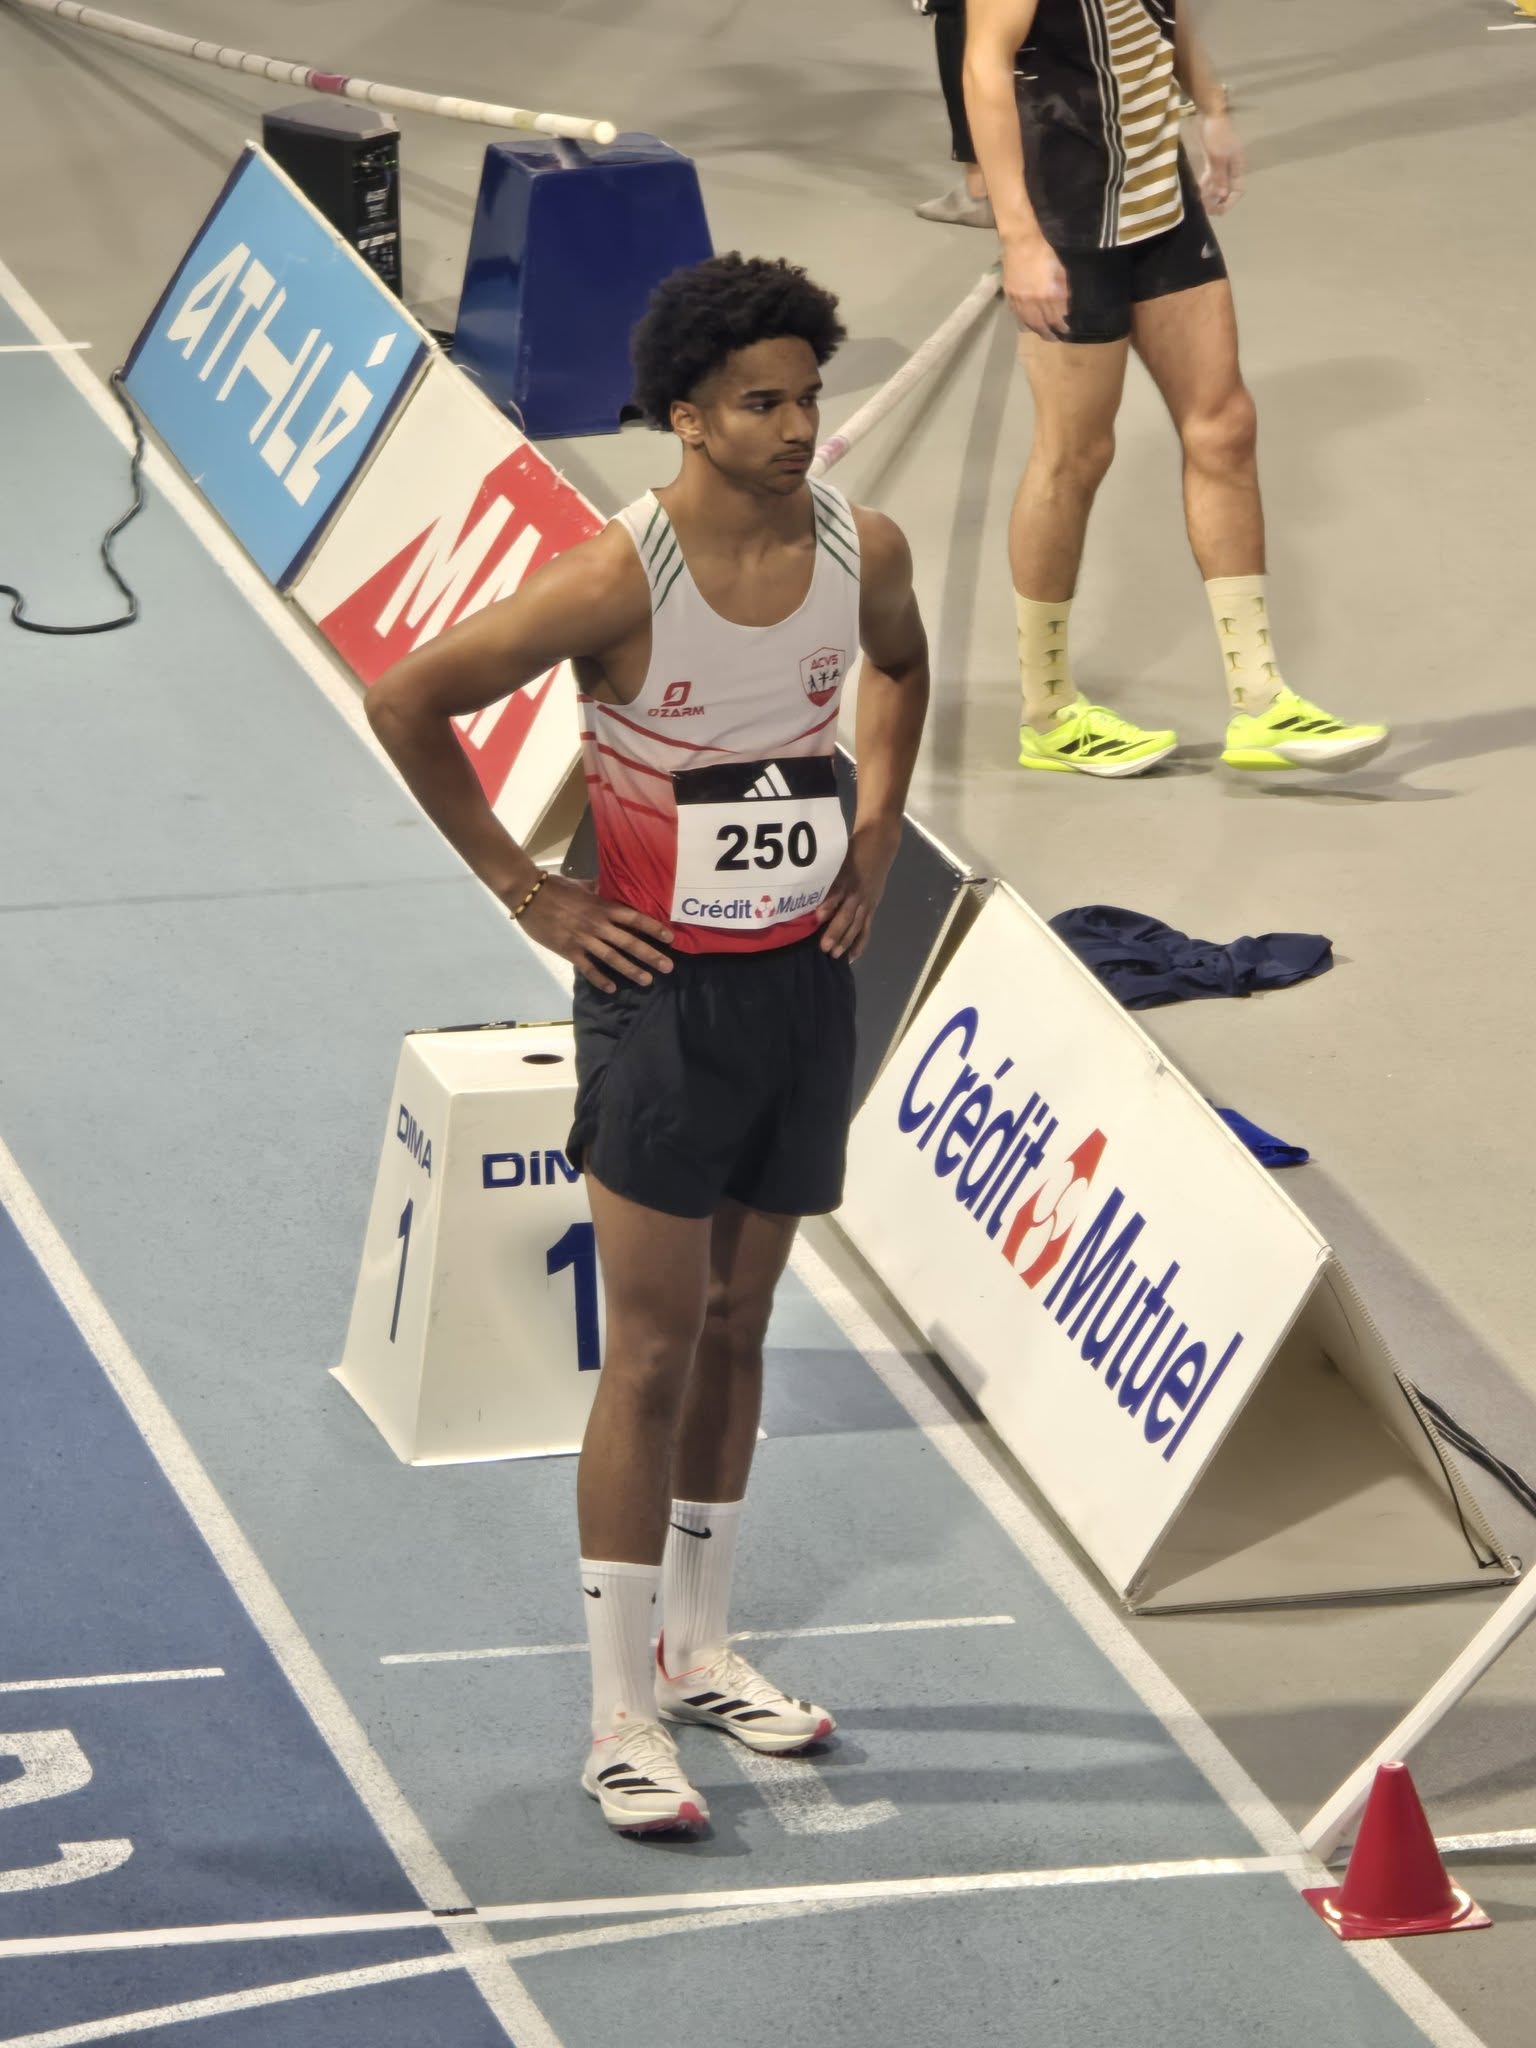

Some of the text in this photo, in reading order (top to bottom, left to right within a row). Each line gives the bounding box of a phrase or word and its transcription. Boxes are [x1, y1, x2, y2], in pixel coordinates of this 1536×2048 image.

[167, 242, 397, 506] ATHLÉ
[811, 654, 839, 670] ACVS
[647, 705, 705, 718] OZARM
[714, 820, 818, 872] 250
[681, 887, 825, 919] Crédit Mutuel
[397, 1104, 432, 1179] DIMA
[389, 1197, 414, 1344] 1
[898, 1006, 1244, 1463] Crédit Mutuel
[546, 1221, 601, 1372] 1
